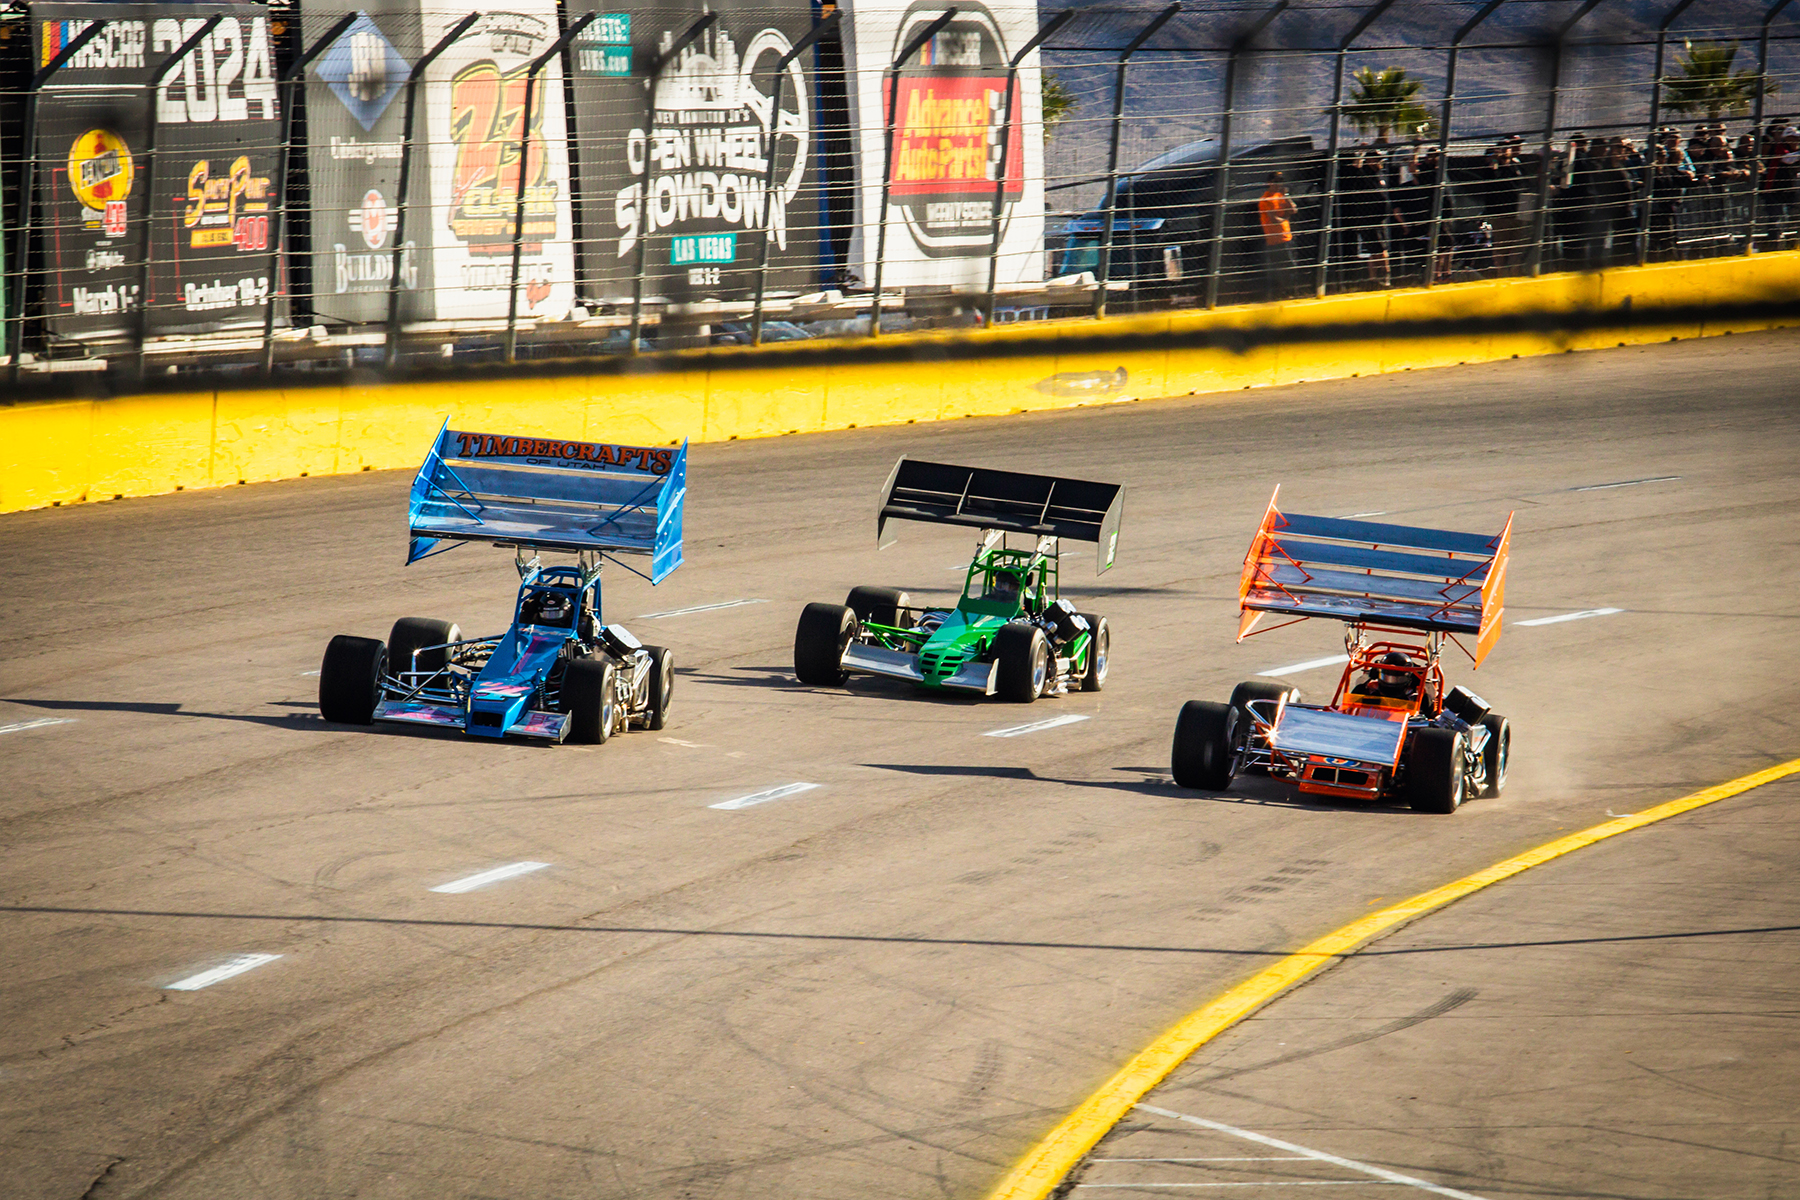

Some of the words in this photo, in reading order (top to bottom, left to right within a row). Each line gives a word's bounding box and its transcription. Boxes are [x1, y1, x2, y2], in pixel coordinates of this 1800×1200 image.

[153, 17, 277, 123] 2024
[902, 88, 984, 138] Advance
[627, 128, 691, 175] OPEN
[694, 126, 769, 173] WHEEL
[231, 215, 268, 251] 400
[615, 171, 787, 258] SHOWDOWN
[334, 240, 418, 294] BUILDIG
[674, 238, 696, 262] LAS
[698, 237, 732, 260] VEGAS
[73, 285, 118, 315] March
[184, 279, 238, 311] October
[456, 432, 673, 475] TIMBERCRAFTS
[526, 457, 552, 467] OF
[557, 459, 606, 471] UTAH
